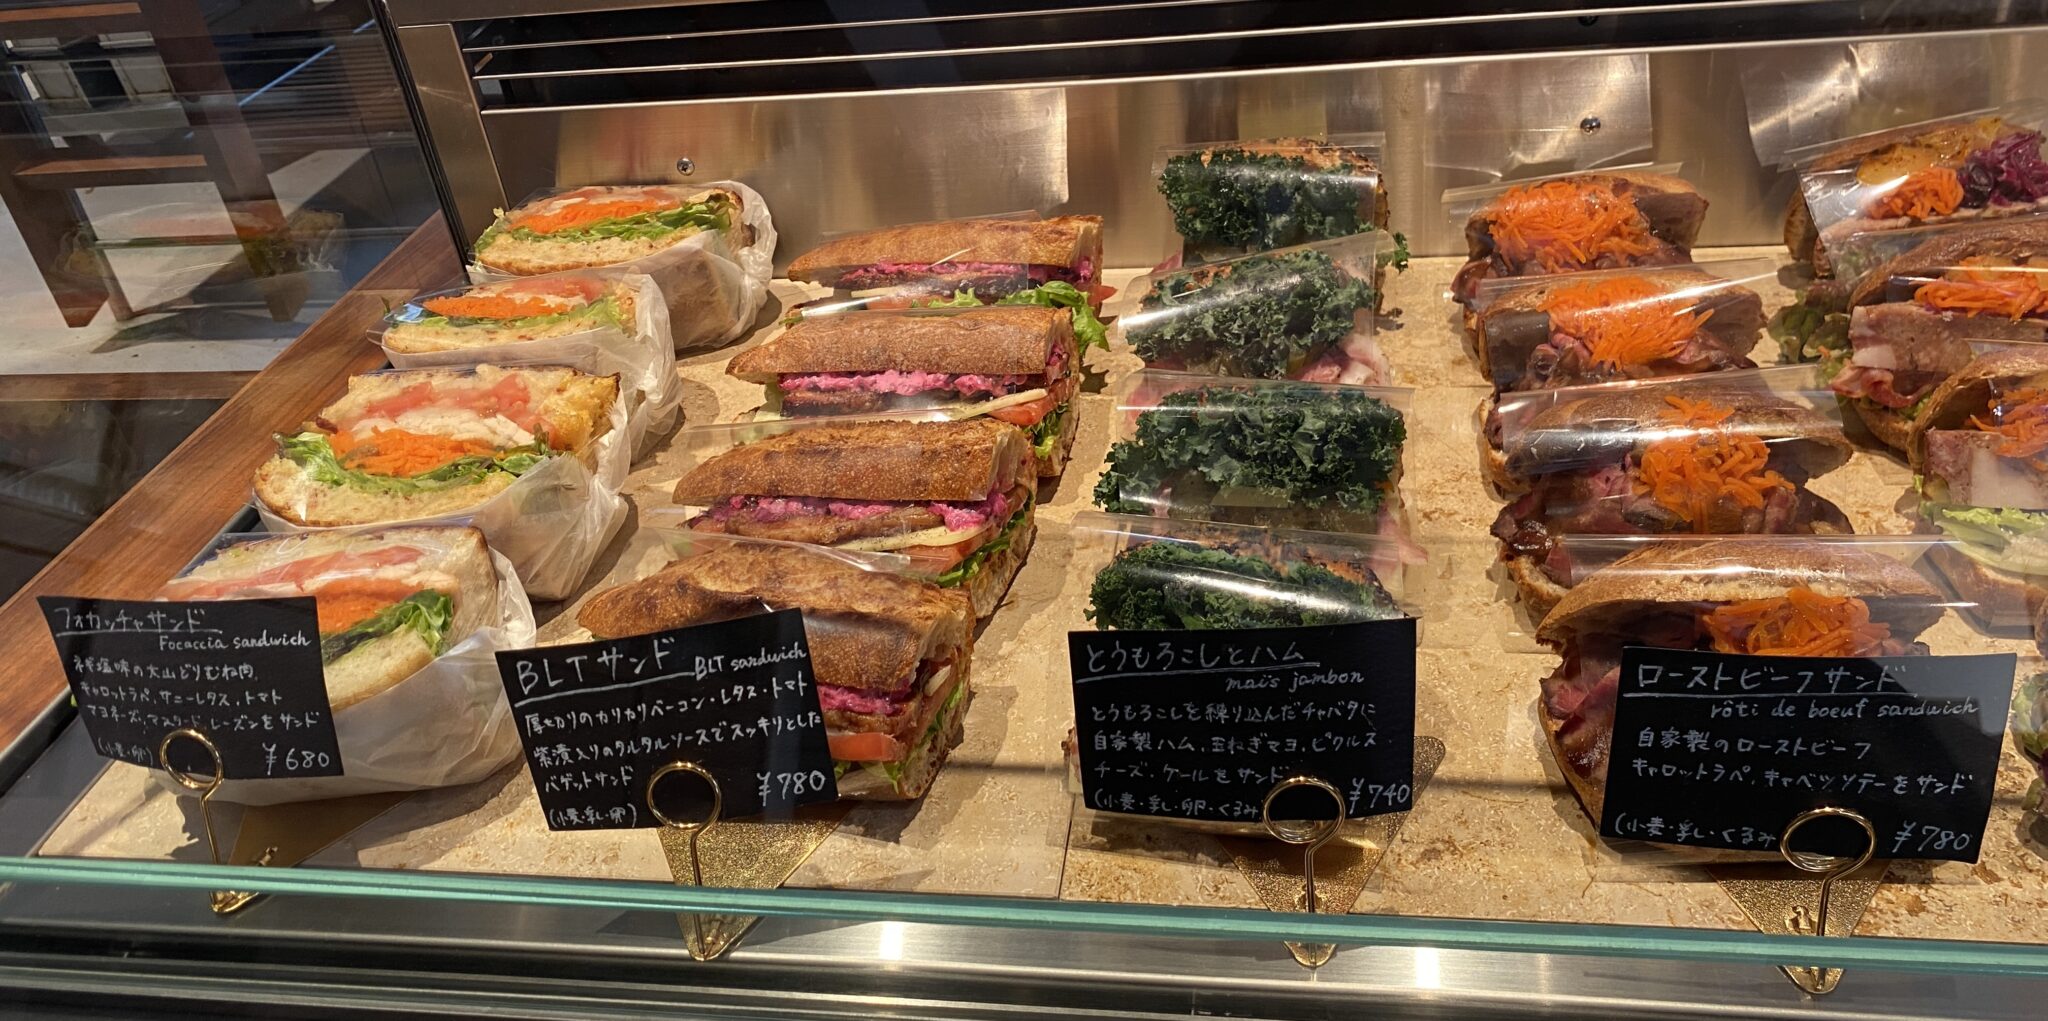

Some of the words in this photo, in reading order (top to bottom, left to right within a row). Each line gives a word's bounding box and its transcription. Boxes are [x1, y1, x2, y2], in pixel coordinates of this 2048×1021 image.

[54, 608, 205, 634] フォカッチャサンド
[159, 635, 229, 650] Focaccia
[233, 629, 312, 648] sandwich
[694, 653, 724, 680] BLT
[731, 641, 807, 671] sandwich
[1087, 641, 1304, 672] とうもろこしとハム
[1289, 670, 1364, 692] jambon
[1638, 662, 1906, 694] ローストビーフサンド
[1711, 699, 1759, 719] rôti
[1771, 698, 1796, 717] de
[1808, 697, 1869, 718] boeuf
[1877, 696, 1980, 717] sandwich
[1638, 727, 1871, 760] 自家製のローストビーフ
[545, 765, 634, 793] バゲットサンド
